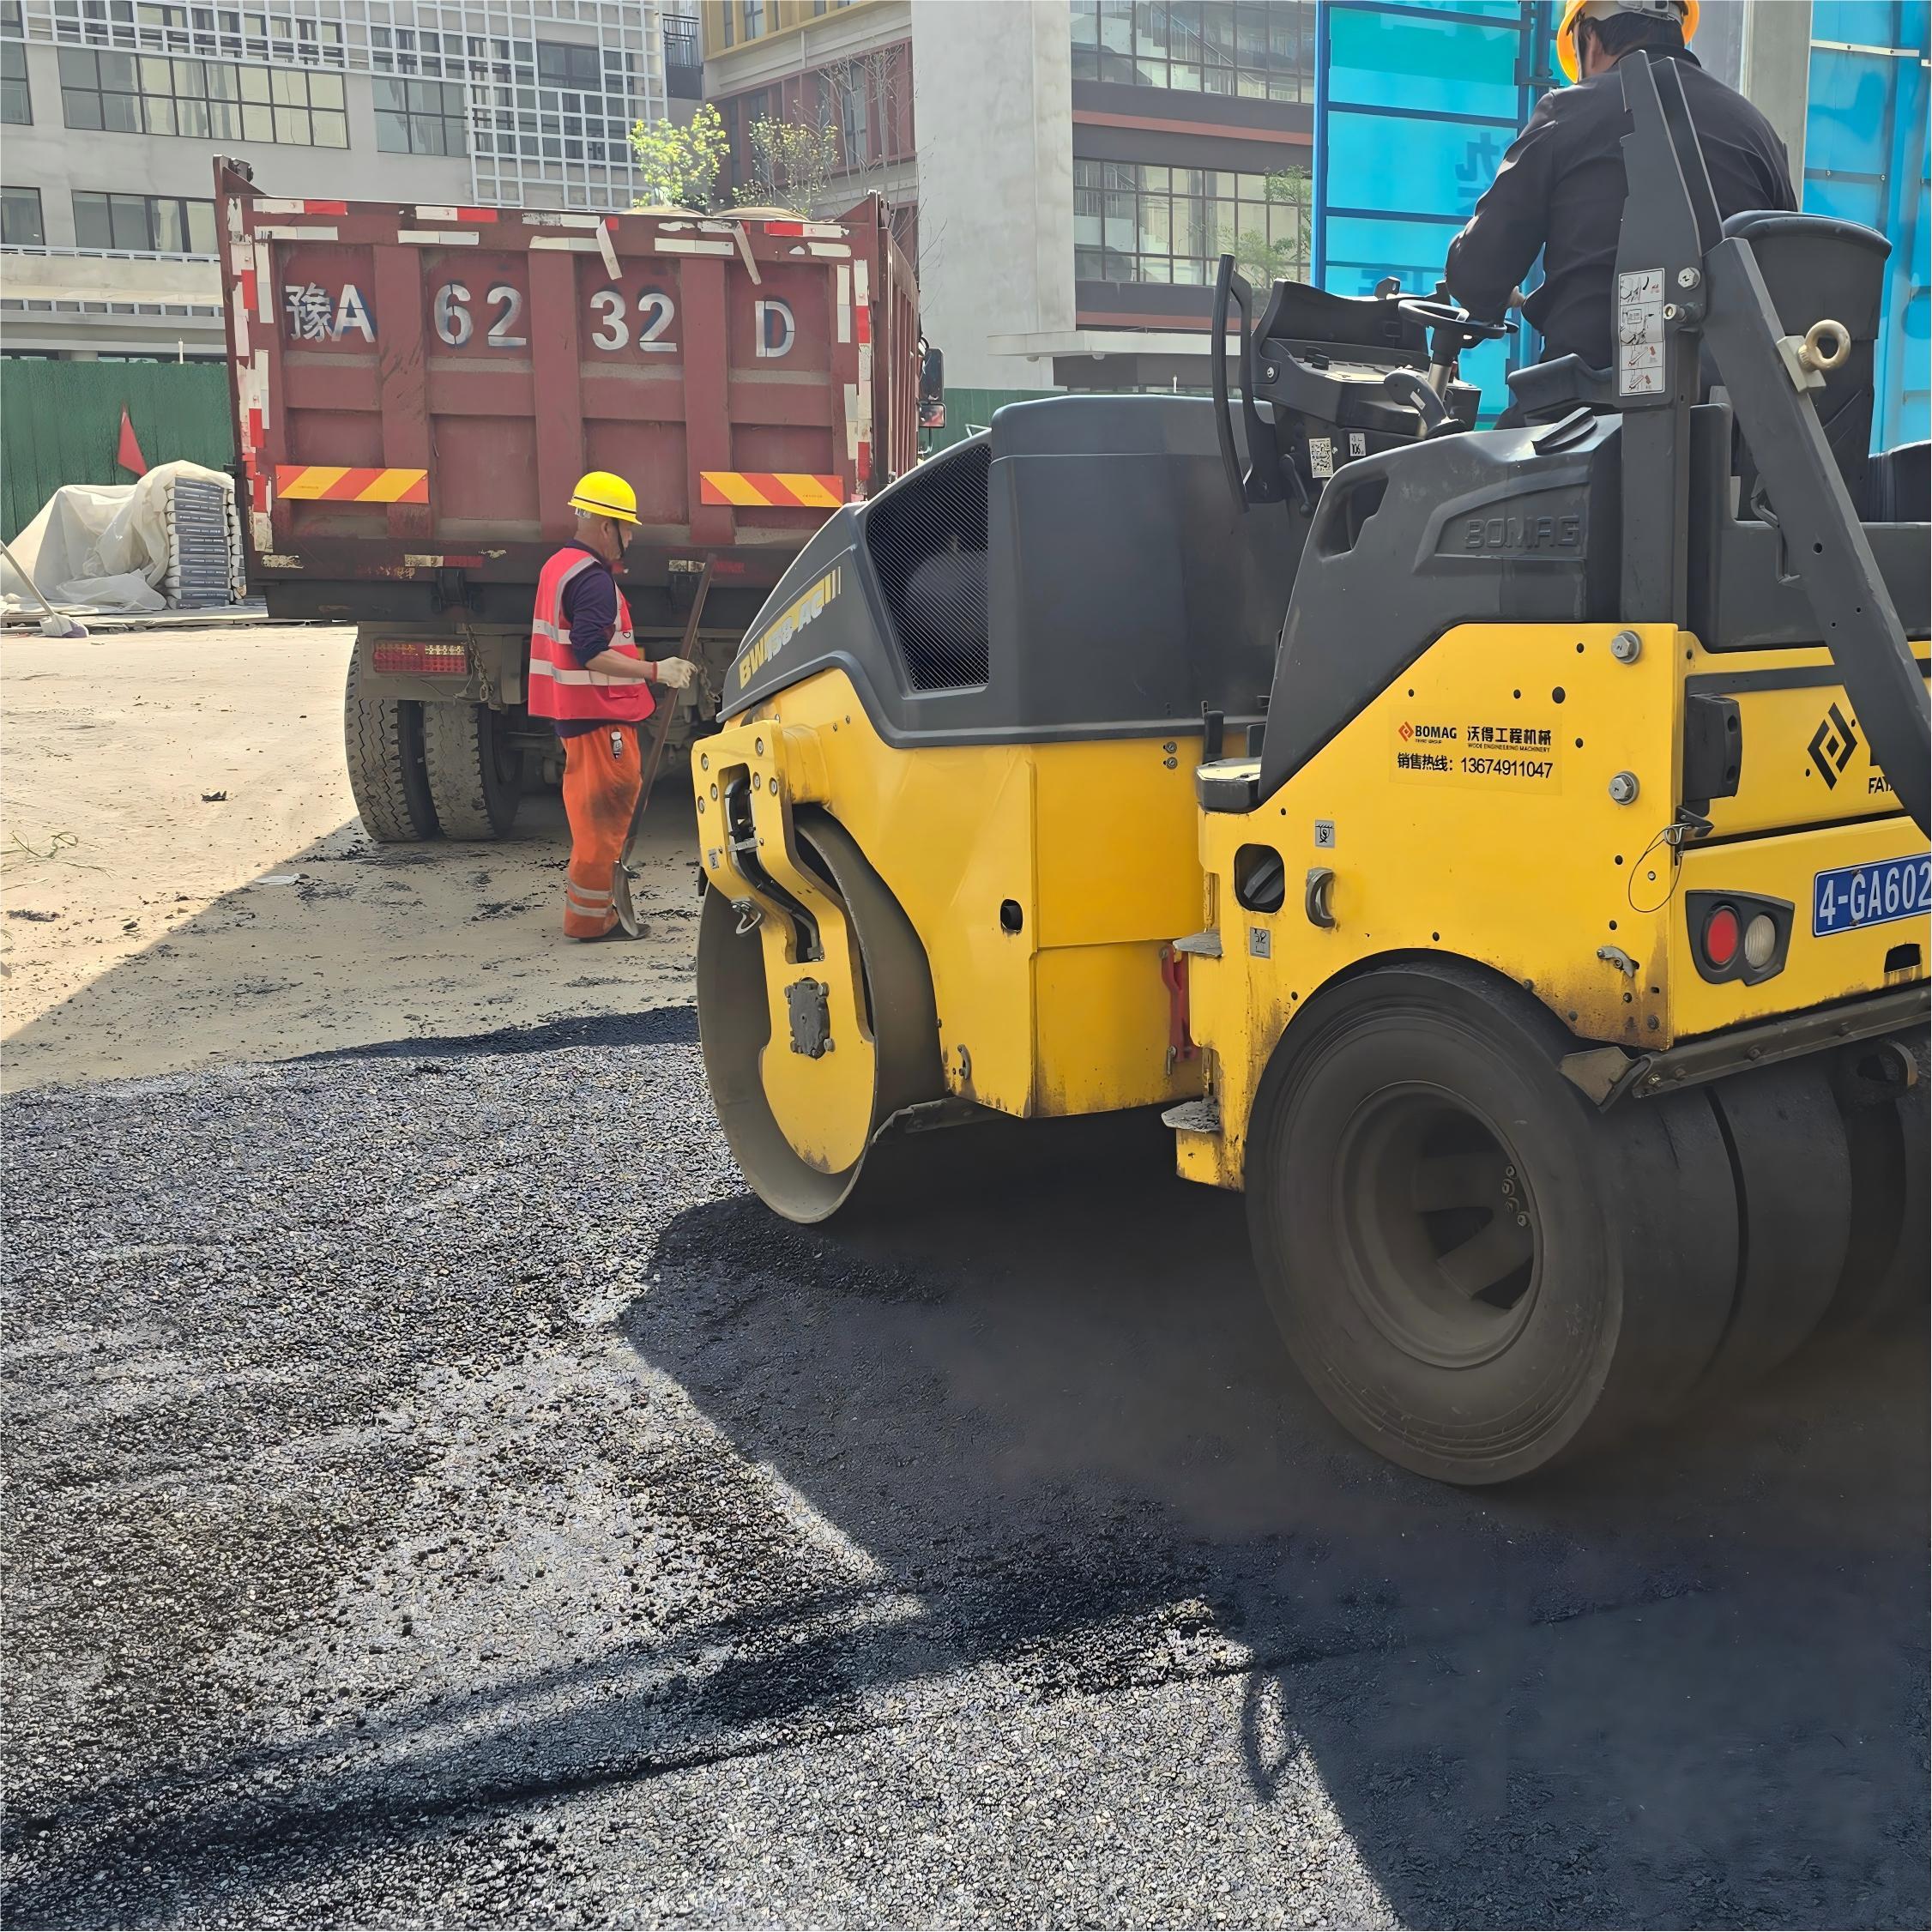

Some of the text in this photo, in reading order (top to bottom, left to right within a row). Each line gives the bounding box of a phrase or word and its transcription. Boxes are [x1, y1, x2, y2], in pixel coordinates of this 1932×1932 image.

[285, 282, 795, 358] 豫A 62 32 D
[1415, 725, 1458, 740] BOMAG
[1467, 726, 1552, 746] 沃得工程机械
[1460, 757, 1554, 779] 13674911047
[1819, 860, 1931, 926] 4-GA602
